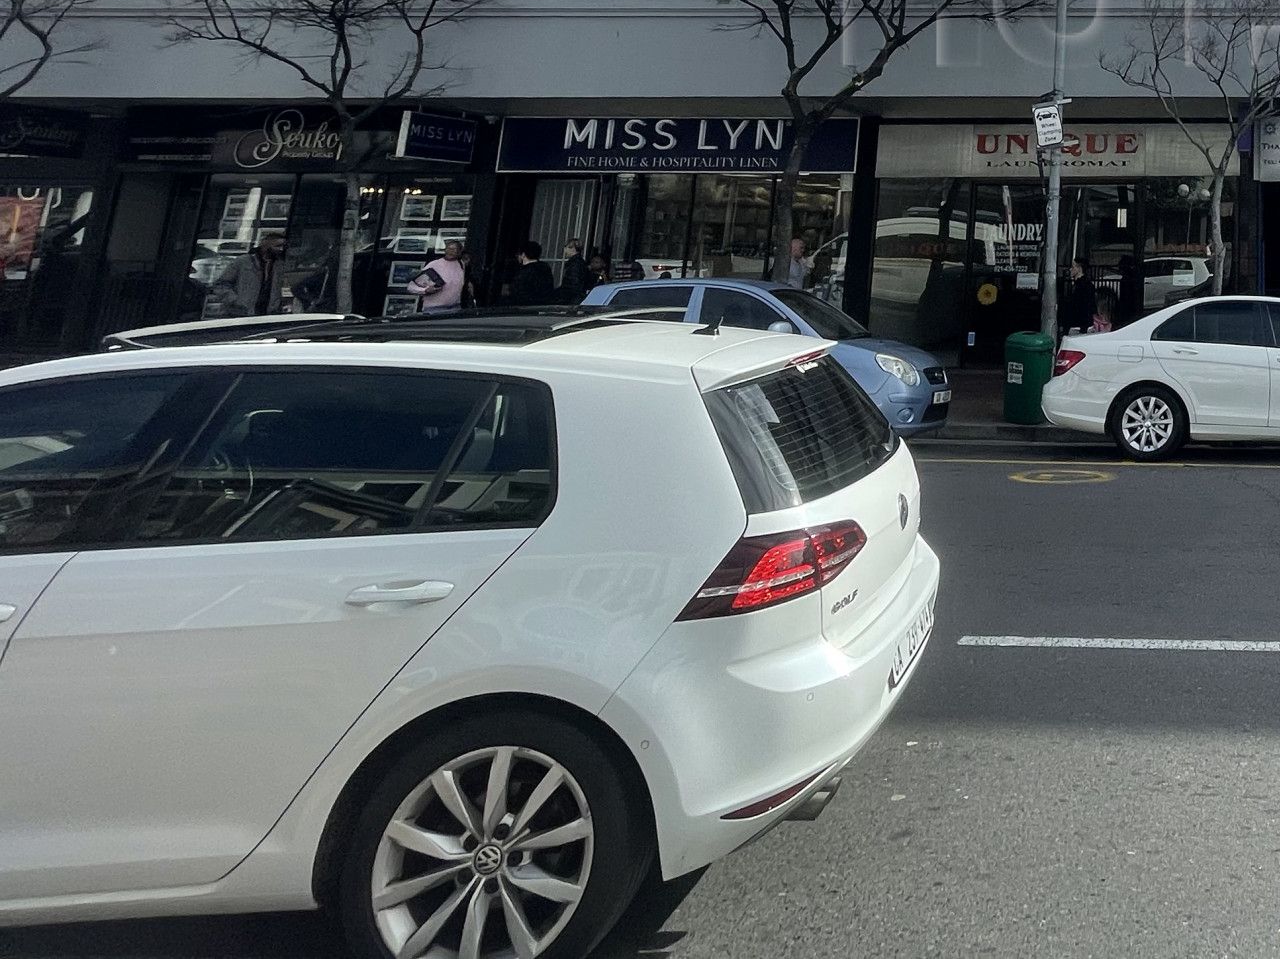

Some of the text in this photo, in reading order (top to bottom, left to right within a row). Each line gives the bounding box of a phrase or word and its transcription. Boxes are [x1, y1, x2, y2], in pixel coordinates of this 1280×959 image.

[410, 123, 473, 143] MISS LYN
[564, 119, 783, 150] MISS LYN
[977, 133, 1139, 157] UNQUE
[567, 156, 778, 168] FINE HOME & HOSPITALITY LINEN
[986, 160, 1131, 168] LAUNROMAT
